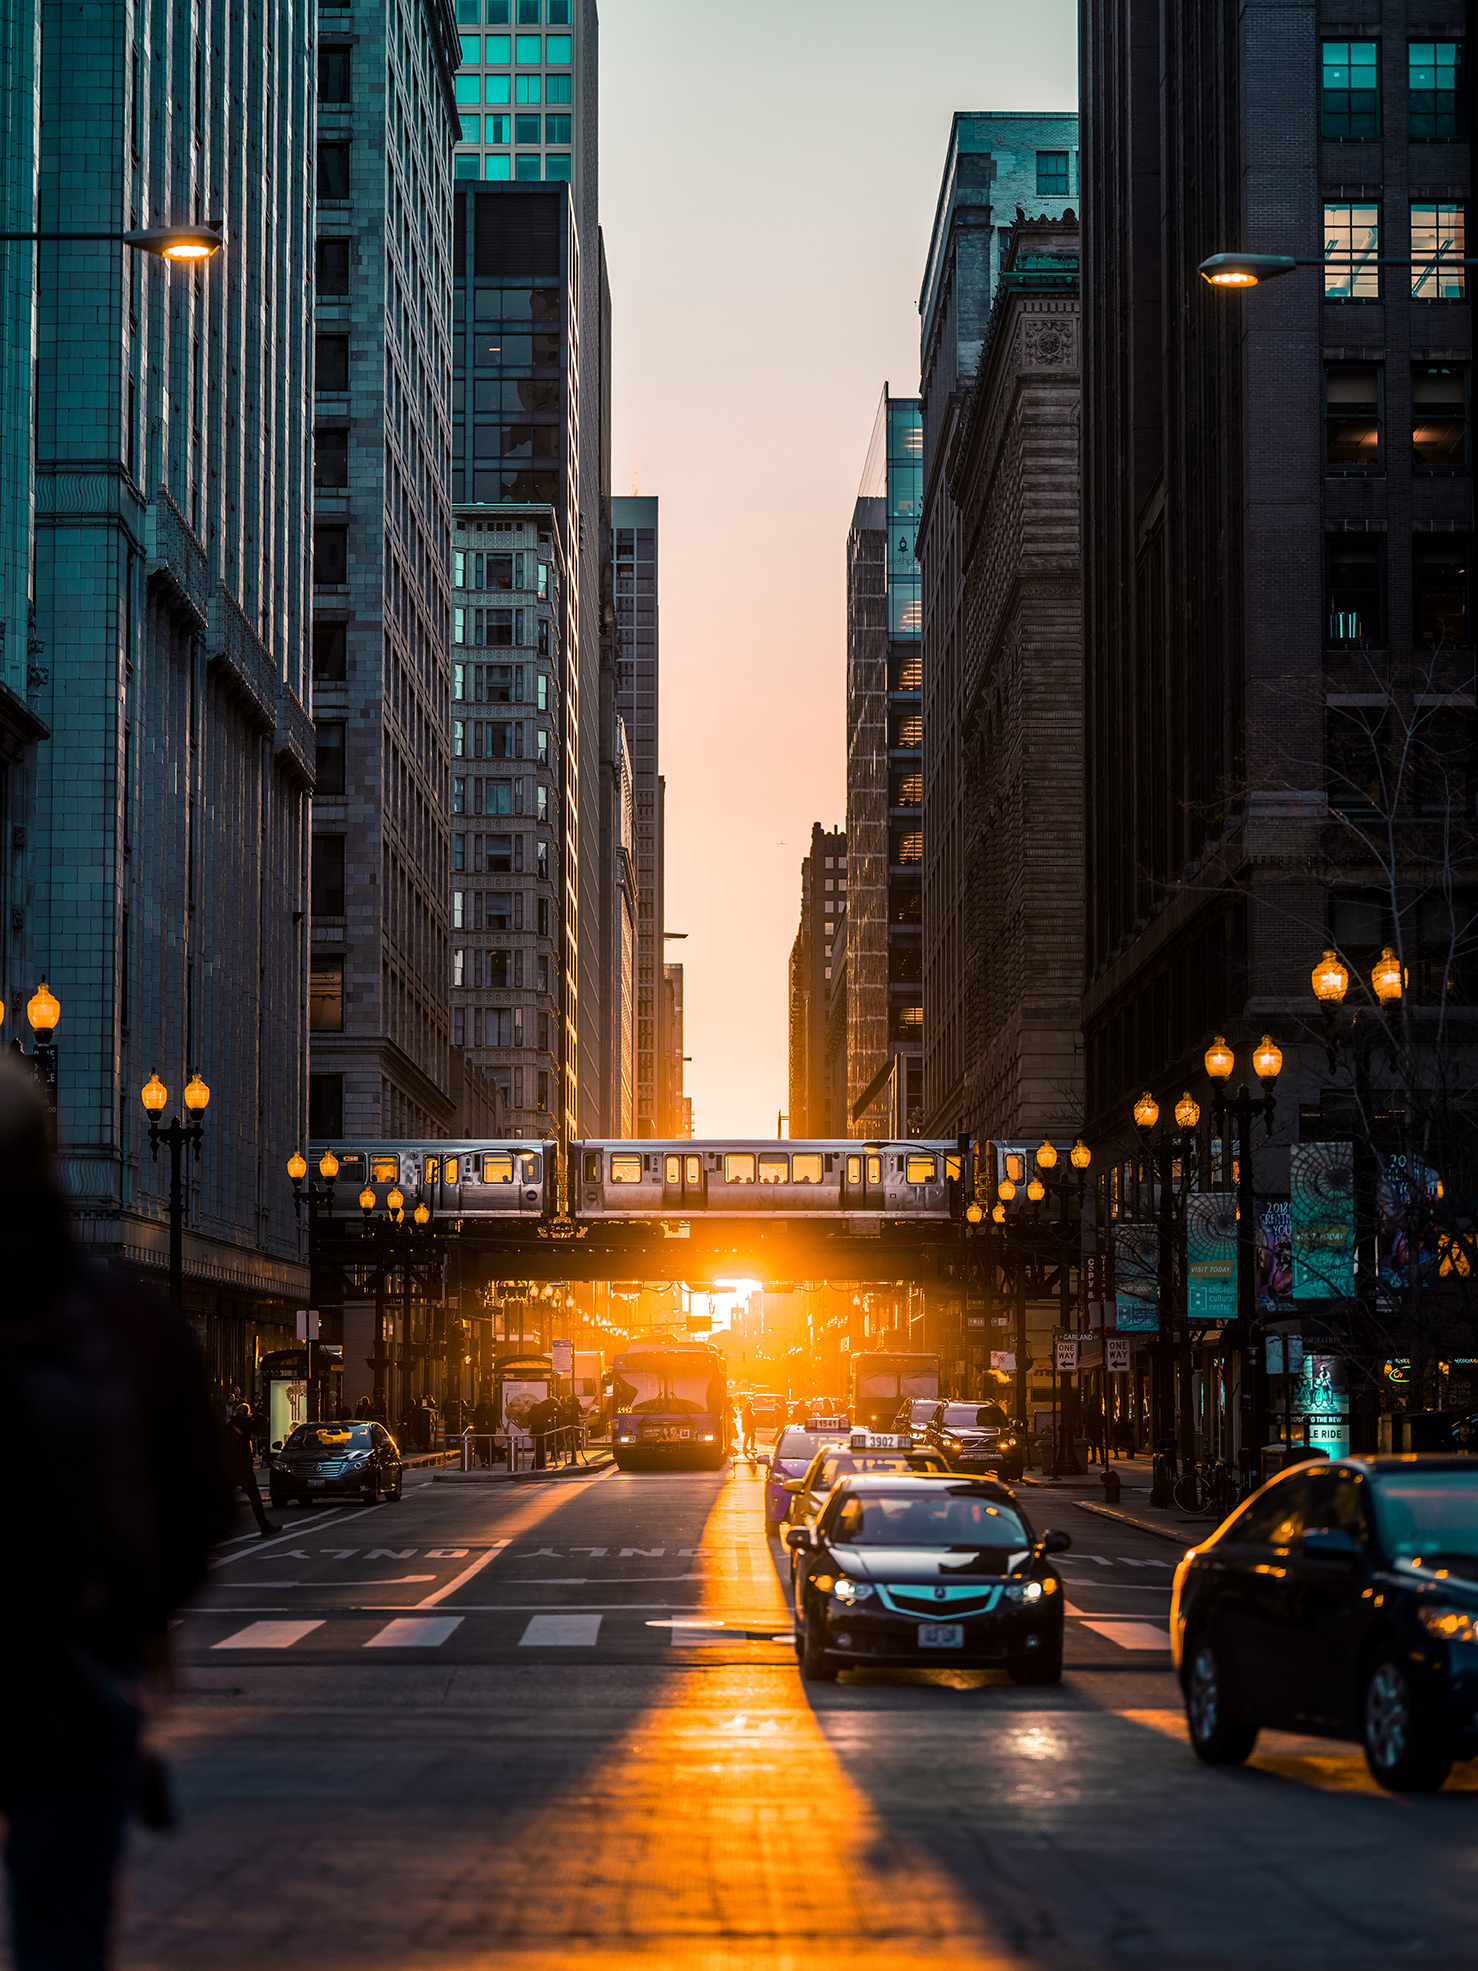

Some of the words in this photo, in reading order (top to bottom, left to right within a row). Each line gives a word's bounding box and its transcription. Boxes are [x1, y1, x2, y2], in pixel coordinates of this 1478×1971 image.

[1209, 1294, 1235, 1302] cultural
[1063, 1333, 1093, 1341] GARLAND
[1058, 1344, 1075, 1352] ONE
[1109, 1341, 1128, 1350] ONE
[1058, 1352, 1075, 1360] WAY
[1109, 1350, 1128, 1359] WAY
[819, 1420, 836, 1428] 1541
[1322, 1430, 1342, 1438] RIDE
[870, 1436, 894, 1447] 3902
[257, 1547, 471, 1560] ONLY
